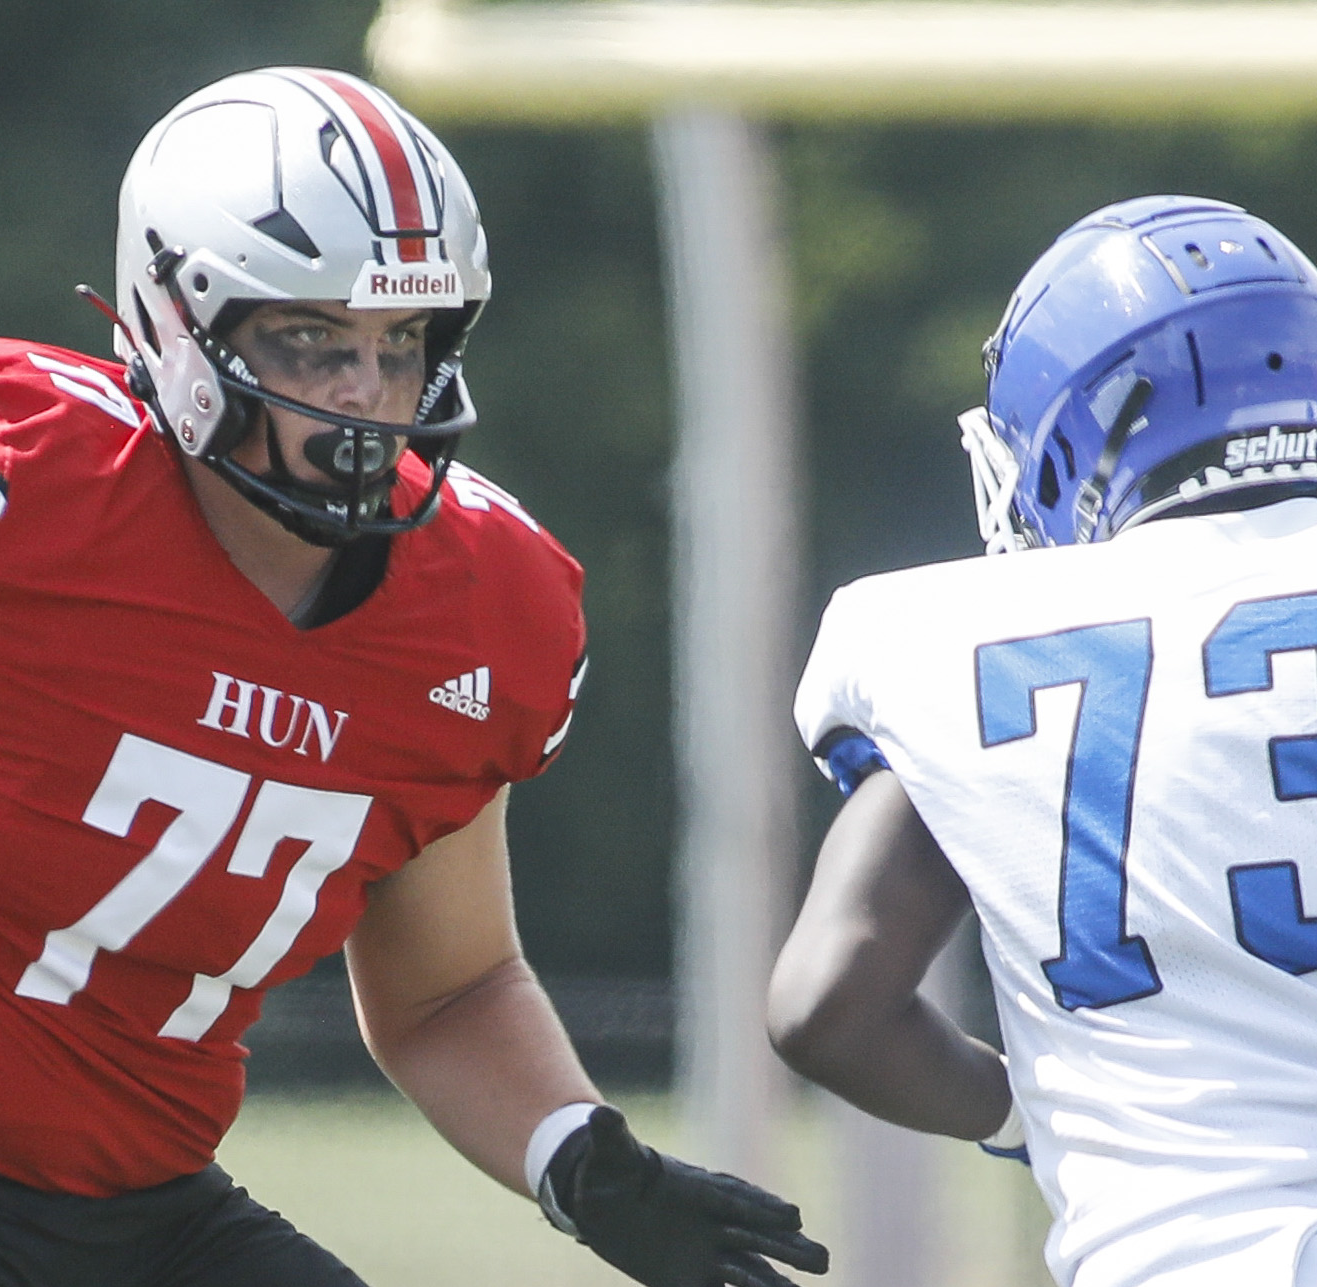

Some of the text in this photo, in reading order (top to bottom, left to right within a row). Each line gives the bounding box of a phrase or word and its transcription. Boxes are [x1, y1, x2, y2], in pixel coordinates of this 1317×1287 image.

[369, 273, 456, 295] Riddell
[196, 671, 348, 762] HUN
[429, 687, 491, 721] adidas
[15, 732, 374, 1043] 77
